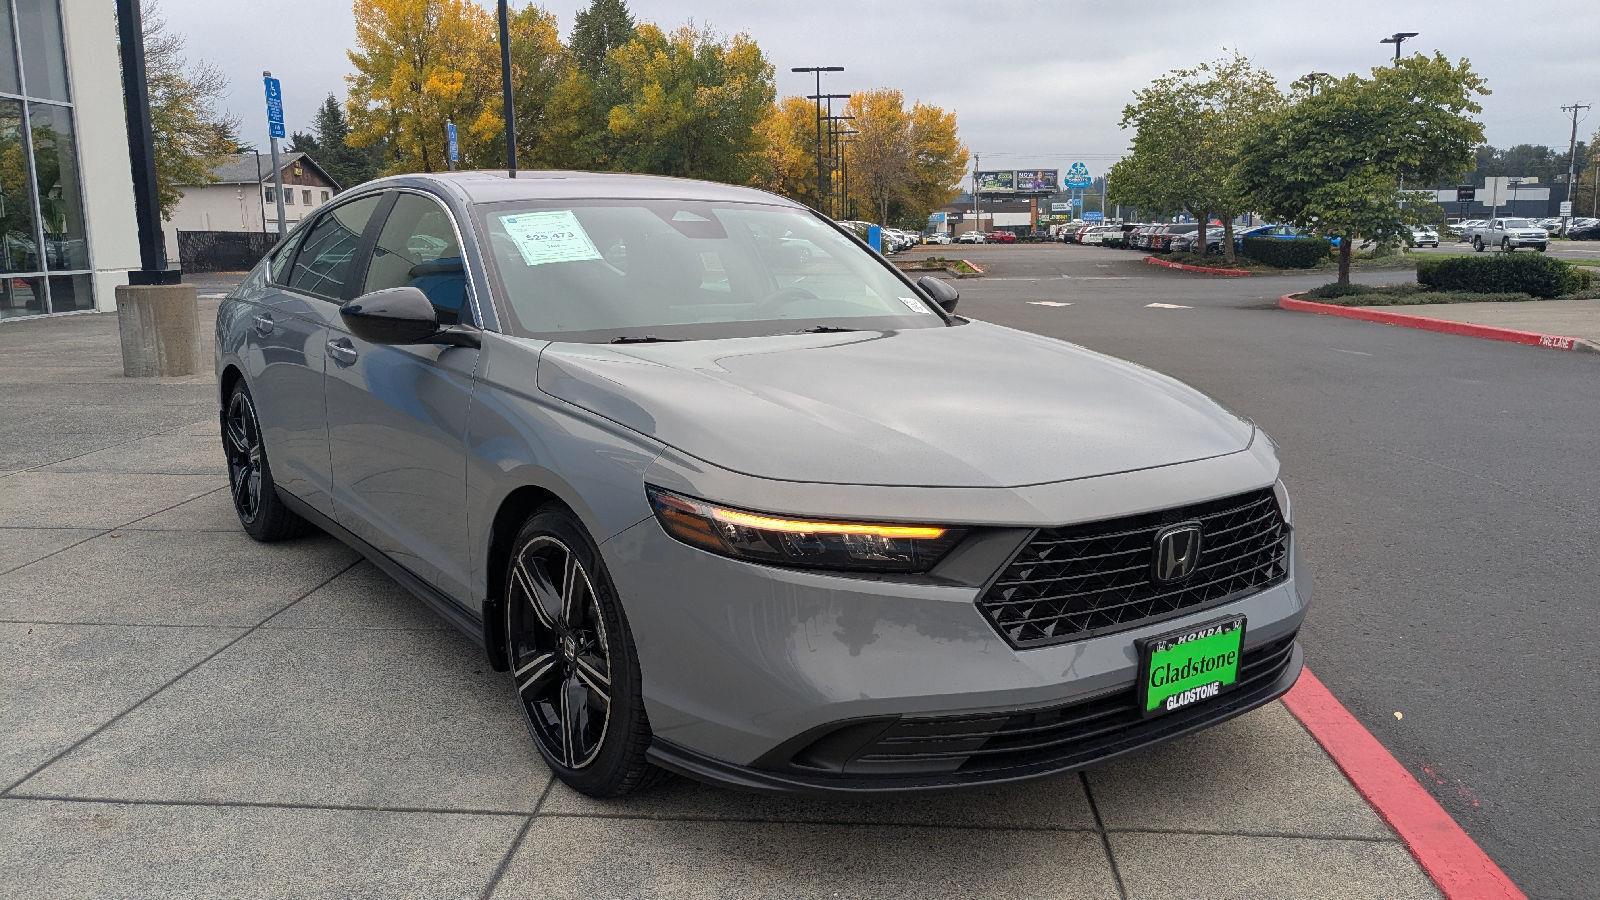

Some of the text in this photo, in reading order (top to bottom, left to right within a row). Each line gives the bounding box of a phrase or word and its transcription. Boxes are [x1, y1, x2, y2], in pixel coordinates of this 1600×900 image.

[1178, 626, 1222, 645] HONDA
[1151, 650, 1236, 688] Gladstone
[1166, 681, 1220, 711] GLADSTONE
